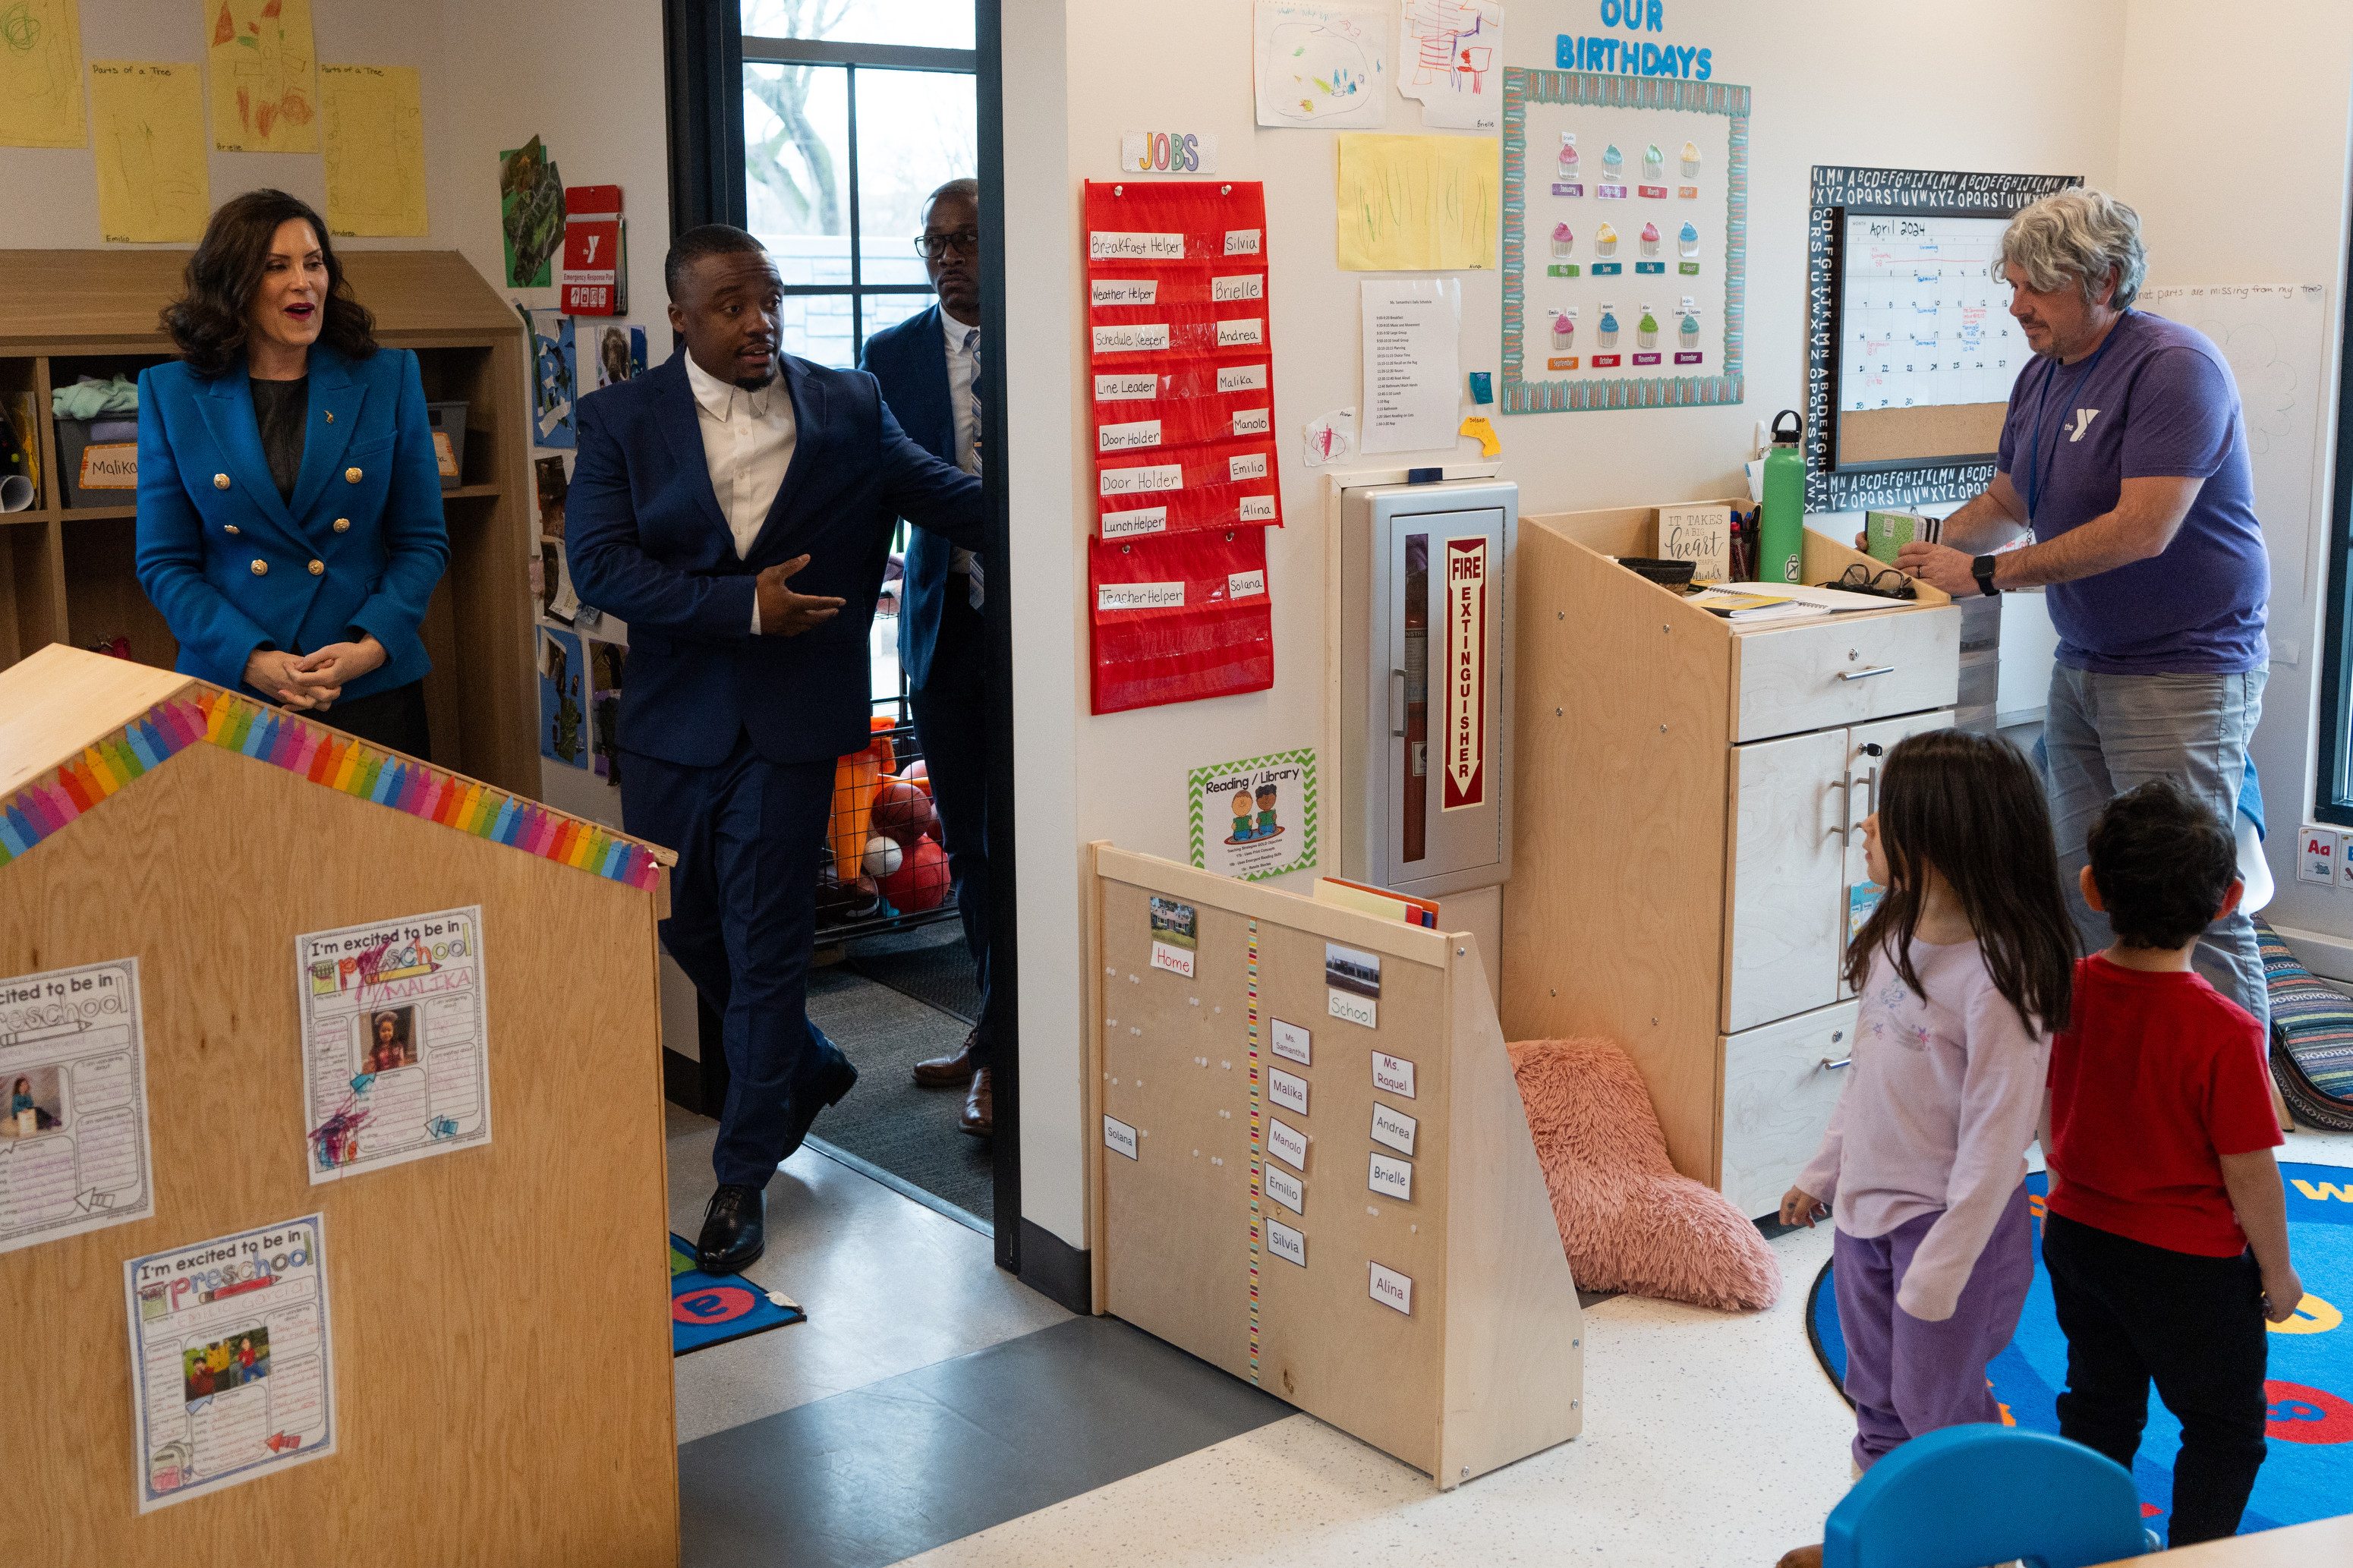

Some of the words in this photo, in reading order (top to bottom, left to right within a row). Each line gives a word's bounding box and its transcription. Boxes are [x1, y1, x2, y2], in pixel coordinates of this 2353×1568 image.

[1601, 0, 1663, 33] OUR
[1556, 34, 1712, 80] BIRTHDAYS
[93, 65, 118, 74] Parts
[150, 67, 172, 76] Tree
[364, 68, 384, 76] Tree
[1476, 119, 1495, 128] Brielle
[1139, 132, 1199, 171] JOBS
[1870, 219, 1895, 238] April
[1901, 222, 1926, 237] 2024
[1091, 235, 1147, 255] Breakfast
[1151, 241, 1181, 257] Helper
[1226, 237, 1257, 250] Silvia
[1559, 266, 1568, 275] May
[1646, 263, 1655, 272] July
[1682, 264, 1696, 272] August
[564, 273, 586, 282] Emergency
[587, 273, 605, 282] Response
[1091, 287, 1126, 301] Weather
[1129, 288, 1154, 301] Helper
[1216, 281, 1259, 299] Brielle
[2157, 288, 2183, 305] parts
[2210, 285, 2248, 299] missing
[2279, 286, 2294, 299] my
[2301, 285, 2323, 293] tree?
[1095, 333, 1132, 347] Schedule
[1135, 334, 1166, 348] Keeper
[1218, 330, 1258, 341] Andrea
[1553, 359, 1574, 367] September
[1098, 381, 1118, 395] Line
[1121, 381, 1154, 393] Leader
[1220, 373, 1253, 386] Malika
[1234, 419, 1268, 430] Manolo
[1101, 433, 1125, 447] Door
[1127, 430, 1160, 445] Holder
[1232, 461, 1264, 475] Emilio
[1102, 476, 1131, 491] Door
[1138, 473, 1179, 489] Holder
[1242, 504, 1271, 516] Alina
[1104, 518, 1132, 533] Lunch
[1133, 517, 1164, 531] Helper
[1668, 515, 1681, 526] IT
[1687, 515, 1723, 525] TAKES
[1665, 527, 1725, 559] heart
[1452, 556, 1481, 581] FIRE
[1230, 580, 1263, 591] Solana
[1099, 589, 1146, 605] Teacher
[1148, 589, 1183, 603] Helper
[1458, 586, 1472, 779] EXTINGUISHER
[1206, 777, 1249, 794] Reading
[1261, 768, 1299, 784] Library
[1268, 838, 1283, 846] Objectives
[2307, 839, 2330, 857] Aa
[311, 942, 339, 957] I'm
[344, 928, 399, 951] excited
[404, 927, 420, 939] to
[424, 923, 443, 937] be
[447, 920, 459, 933] in
[1157, 947, 1190, 973] Home
[46, 983, 65, 997] to
[71, 978, 93, 992] be
[99, 974, 113, 987] in
[1331, 997, 1372, 1025] School
[1285, 1033, 1296, 1043] Ms.
[1276, 1042, 1306, 1059] Samantha
[1384, 1056, 1399, 1071] Ms.
[1274, 1080, 1303, 1100] Malika
[1378, 1072, 1406, 1091] Raquel
[1107, 1126, 1132, 1147] Solana
[1377, 1116, 1410, 1139] Andrea
[1273, 1131, 1302, 1155] Manolo
[1375, 1166, 1406, 1186] Brielle
[1270, 1176, 1298, 1201] Emilio
[1272, 1232, 1299, 1254] Silvia
[141, 1264, 172, 1280] I'm
[176, 1245, 236, 1270] excited
[241, 1241, 258, 1255] to
[263, 1234, 283, 1248] be
[288, 1230, 301, 1243] in
[170, 1230, 313, 1312] preschool
[1376, 1277, 1403, 1299] Alina
